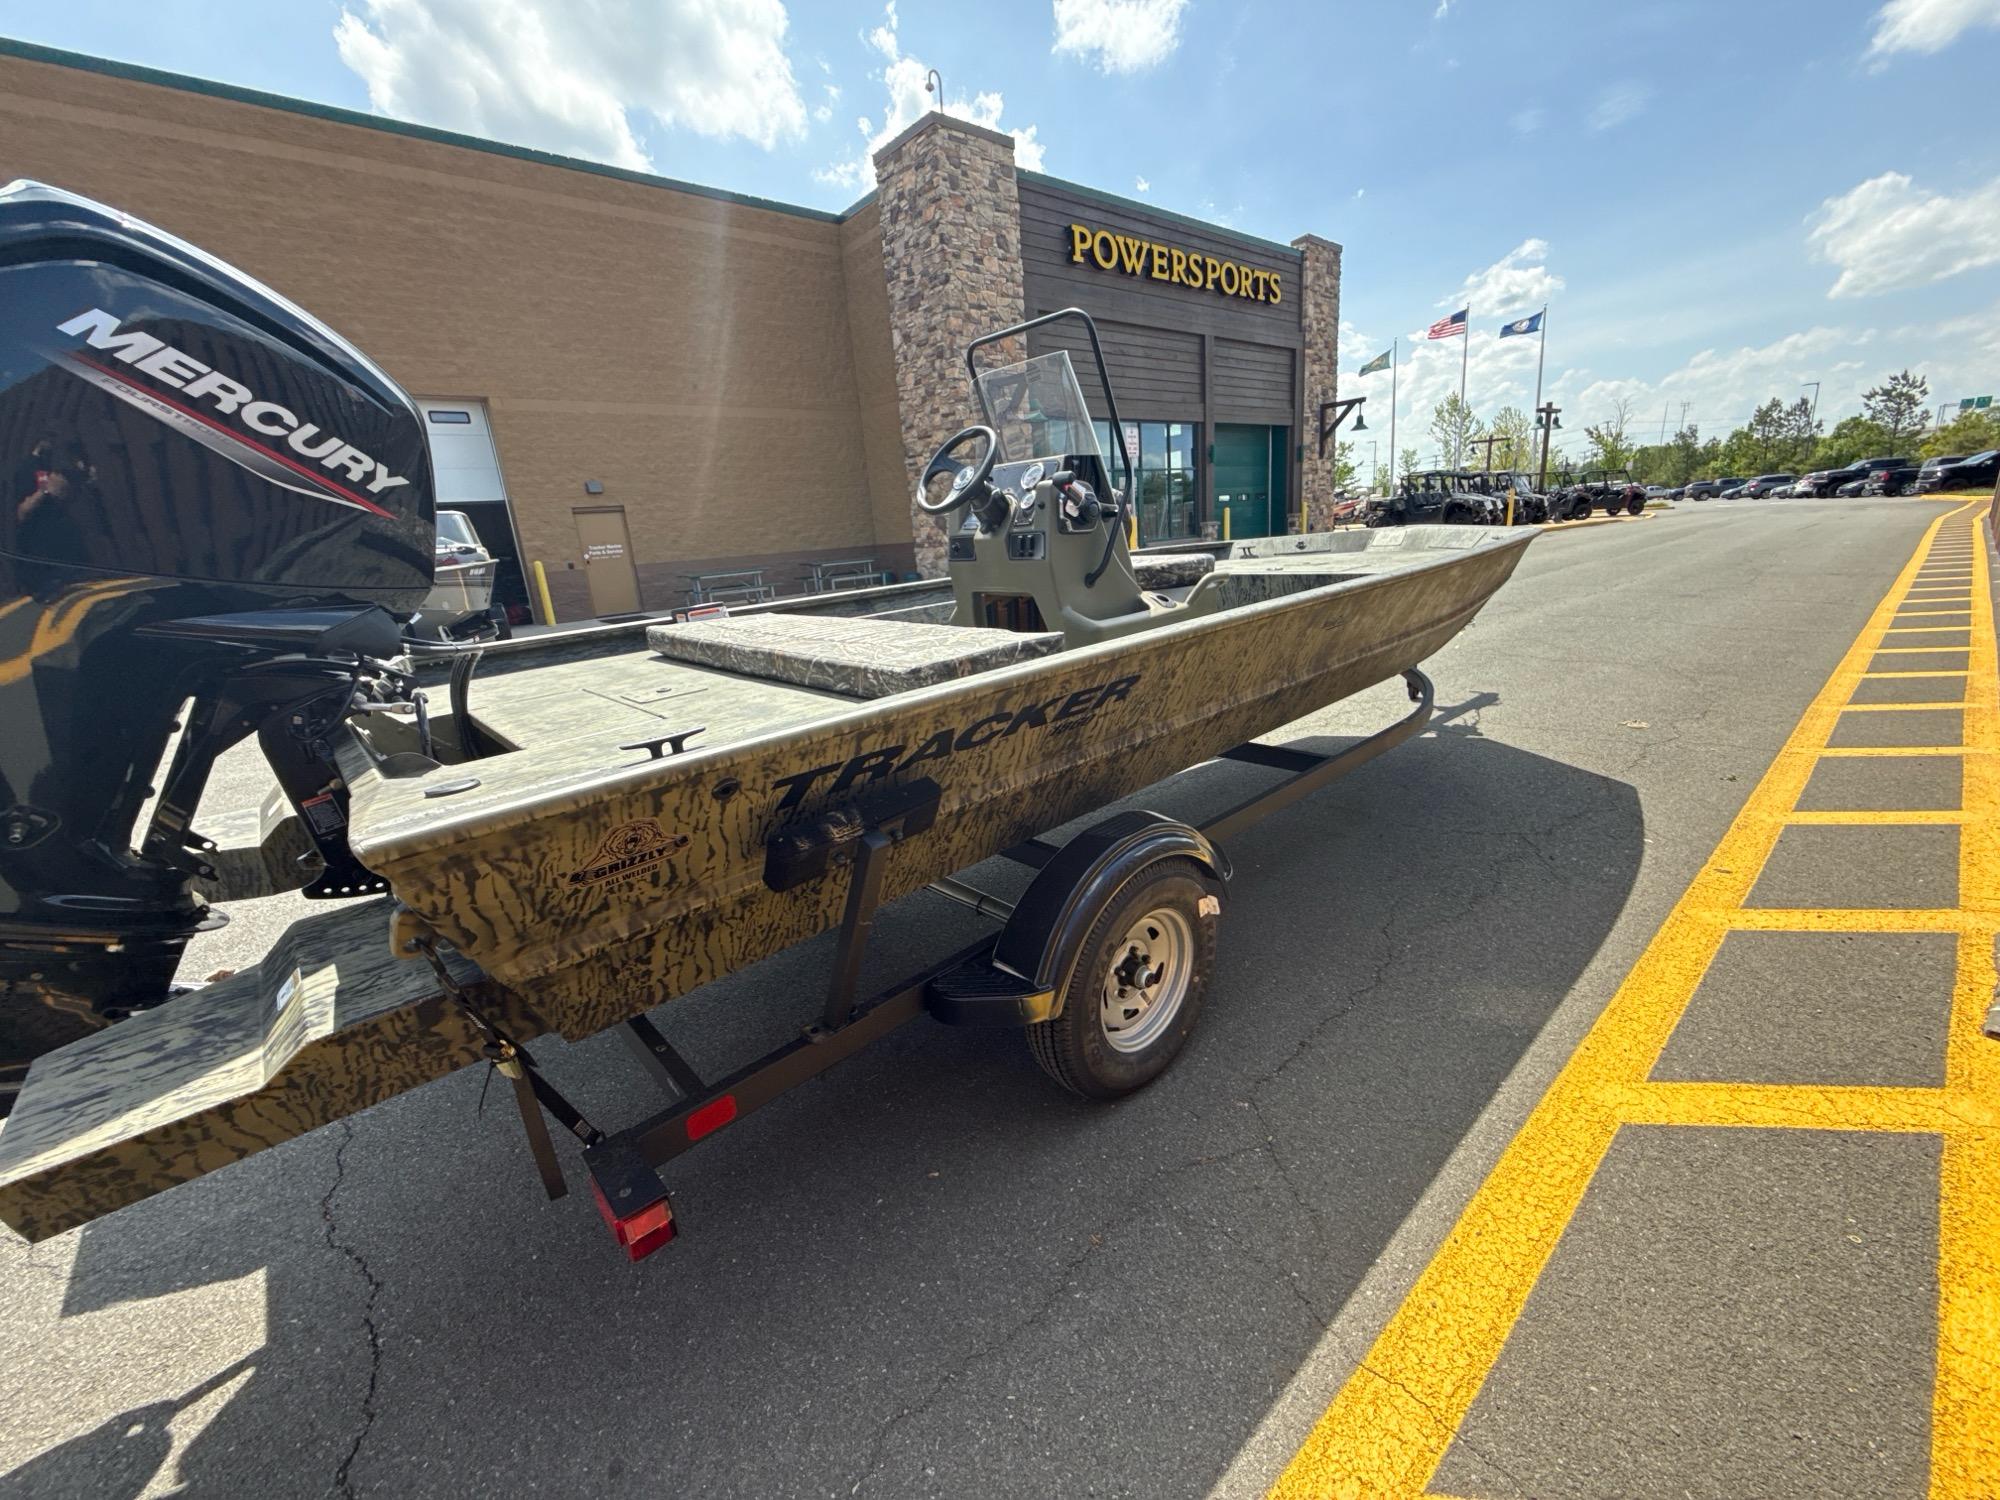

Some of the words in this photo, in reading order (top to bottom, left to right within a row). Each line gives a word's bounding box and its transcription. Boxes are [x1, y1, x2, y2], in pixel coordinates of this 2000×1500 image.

[1070, 223, 1282, 304] POWERSPORTS
[56, 308, 410, 494] MERCURY
[771, 674, 1141, 812] TRACKER
[593, 846, 667, 879] GRIZZLY
[605, 877, 620, 888] ALL
[622, 863, 659, 881] WELDED
